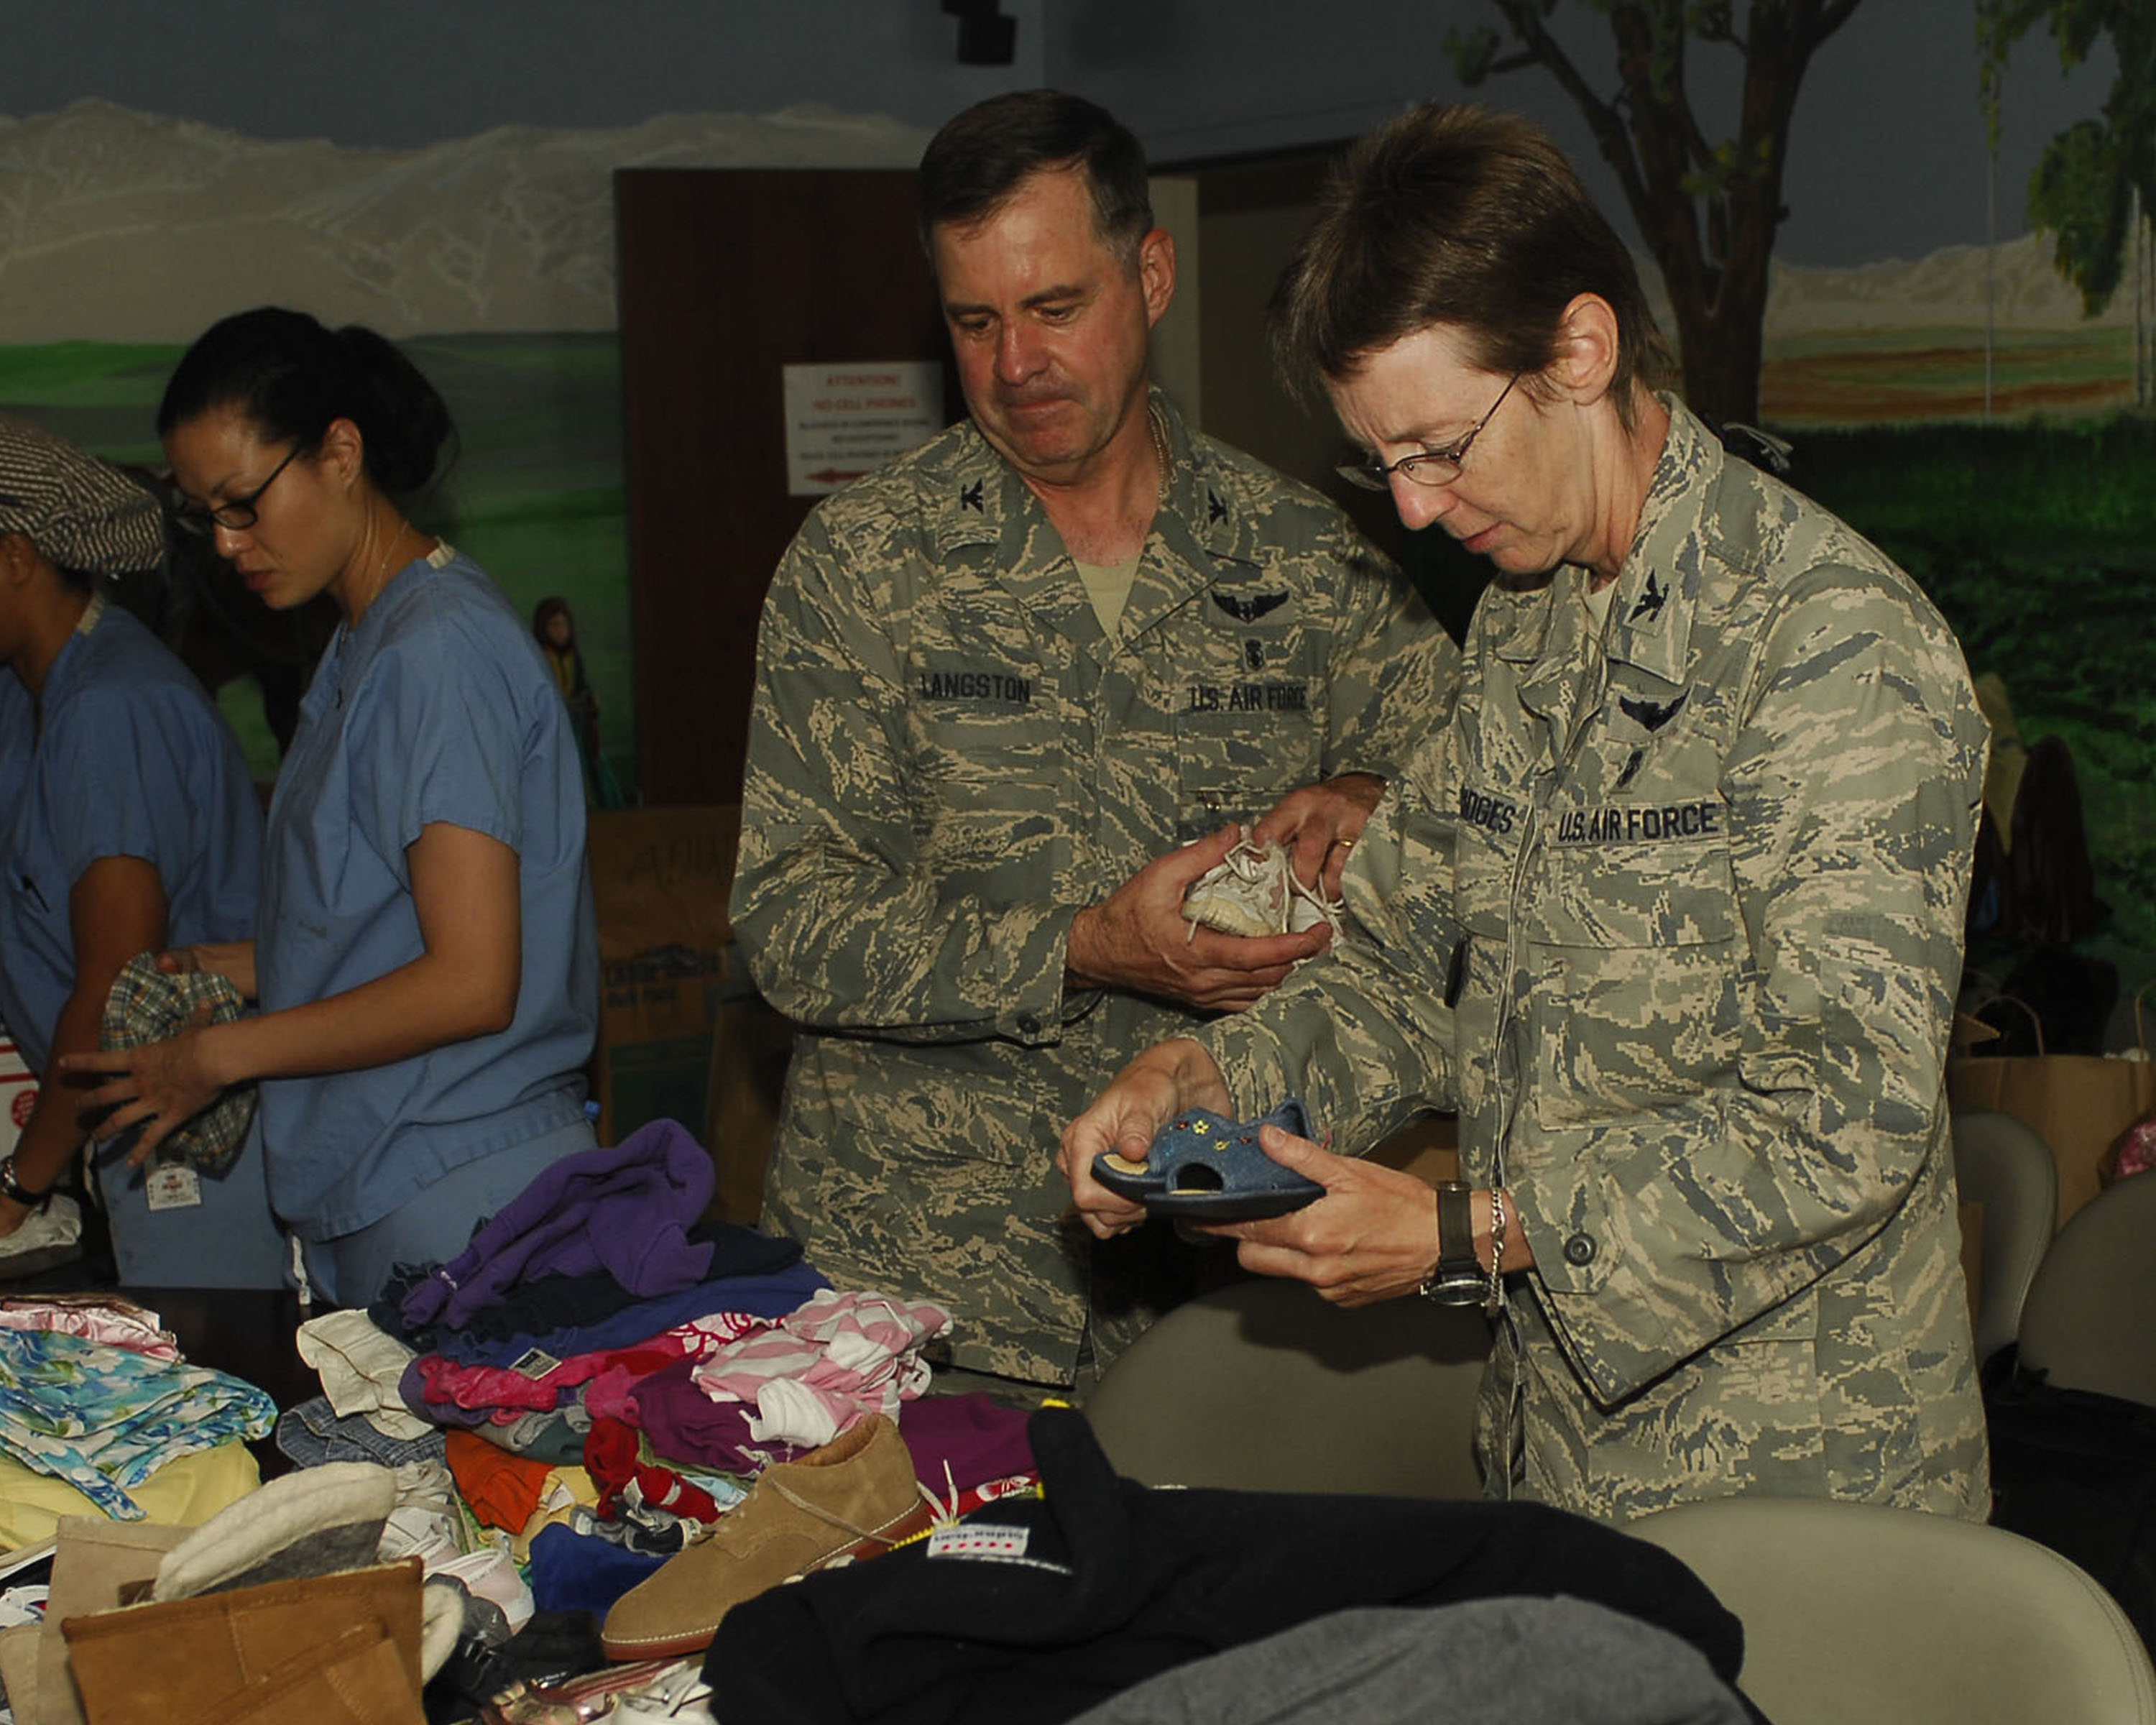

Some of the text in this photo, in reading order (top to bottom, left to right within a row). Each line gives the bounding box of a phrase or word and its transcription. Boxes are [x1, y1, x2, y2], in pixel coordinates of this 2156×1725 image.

[921, 672, 1031, 702] LANGSTON
[1229, 684, 1262, 711] AIR
[1267, 685, 1307, 710] FORCE
[1557, 802, 1718, 842] U.S. AIR FORCE
